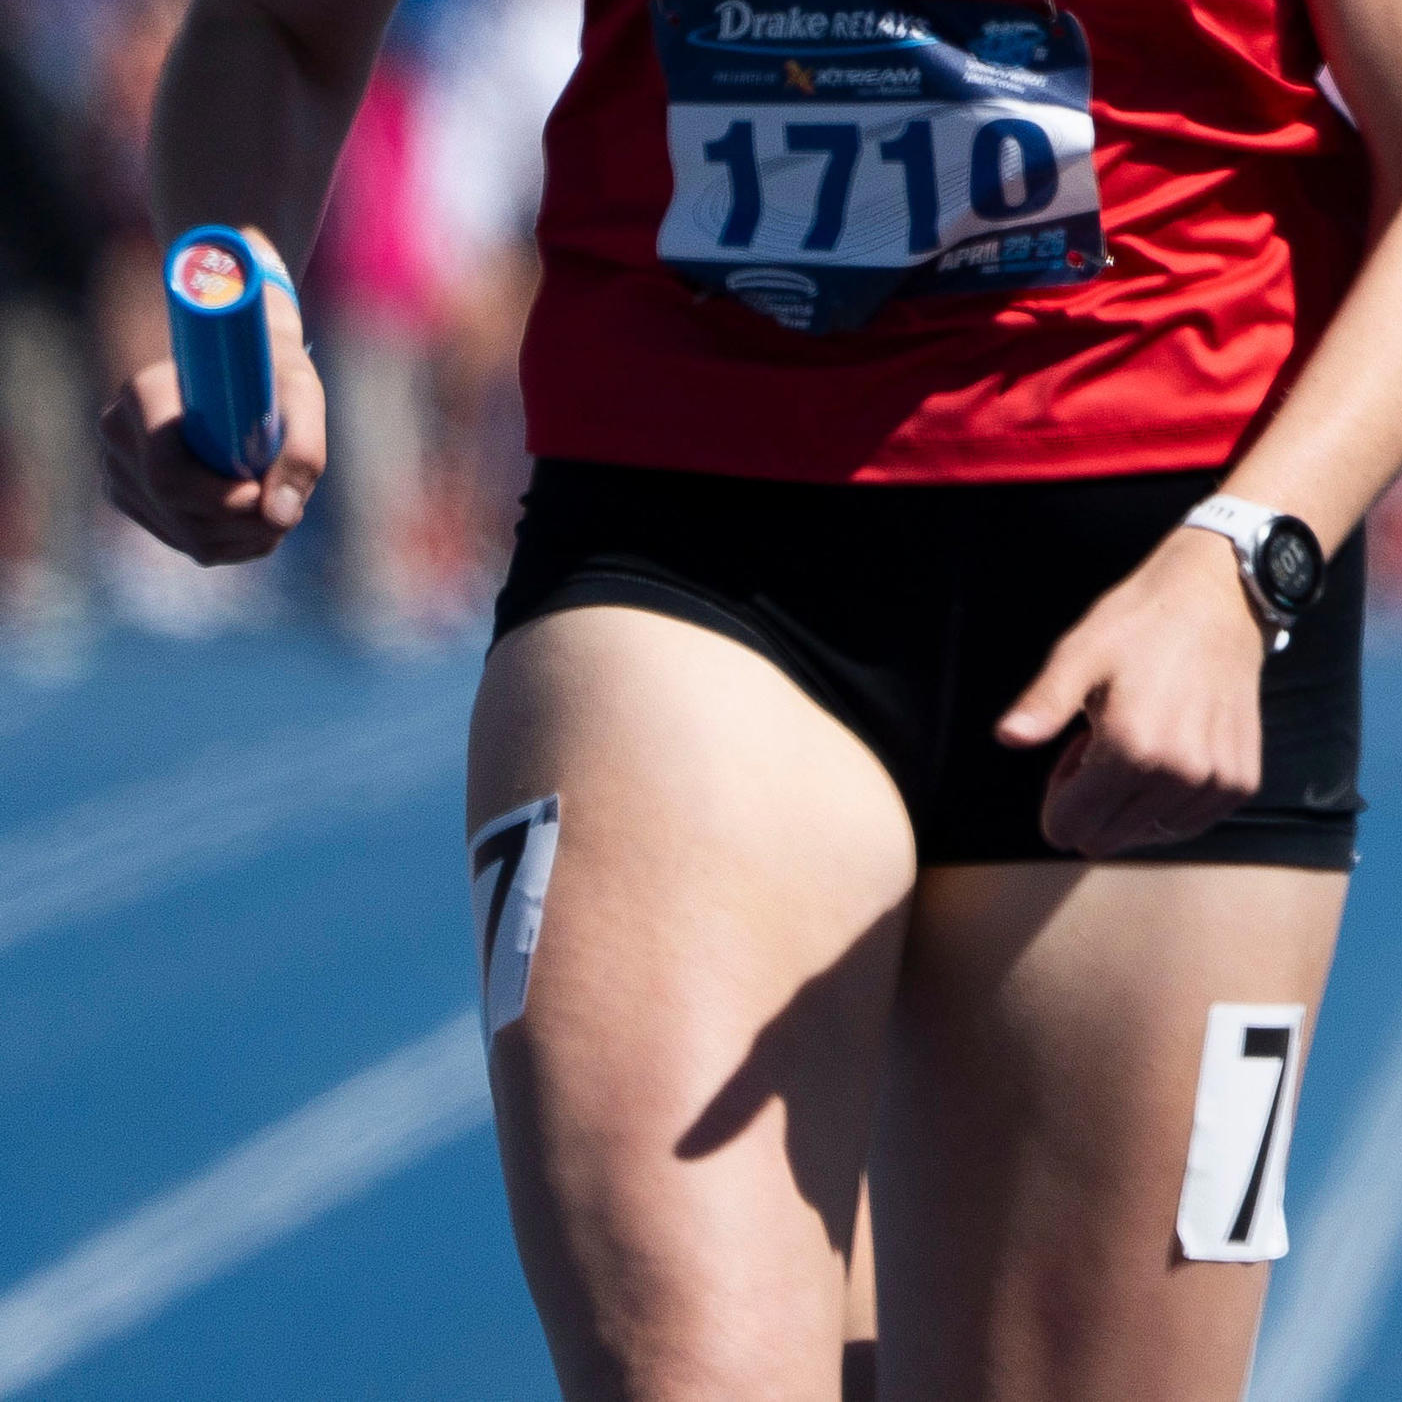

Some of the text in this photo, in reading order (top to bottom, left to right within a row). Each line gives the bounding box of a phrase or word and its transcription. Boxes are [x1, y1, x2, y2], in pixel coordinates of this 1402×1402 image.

[715, 0, 828, 41] Drake
[705, 118, 1059, 255] 1710
[473, 817, 532, 991] 7
[1226, 1026, 1290, 1244] 7
